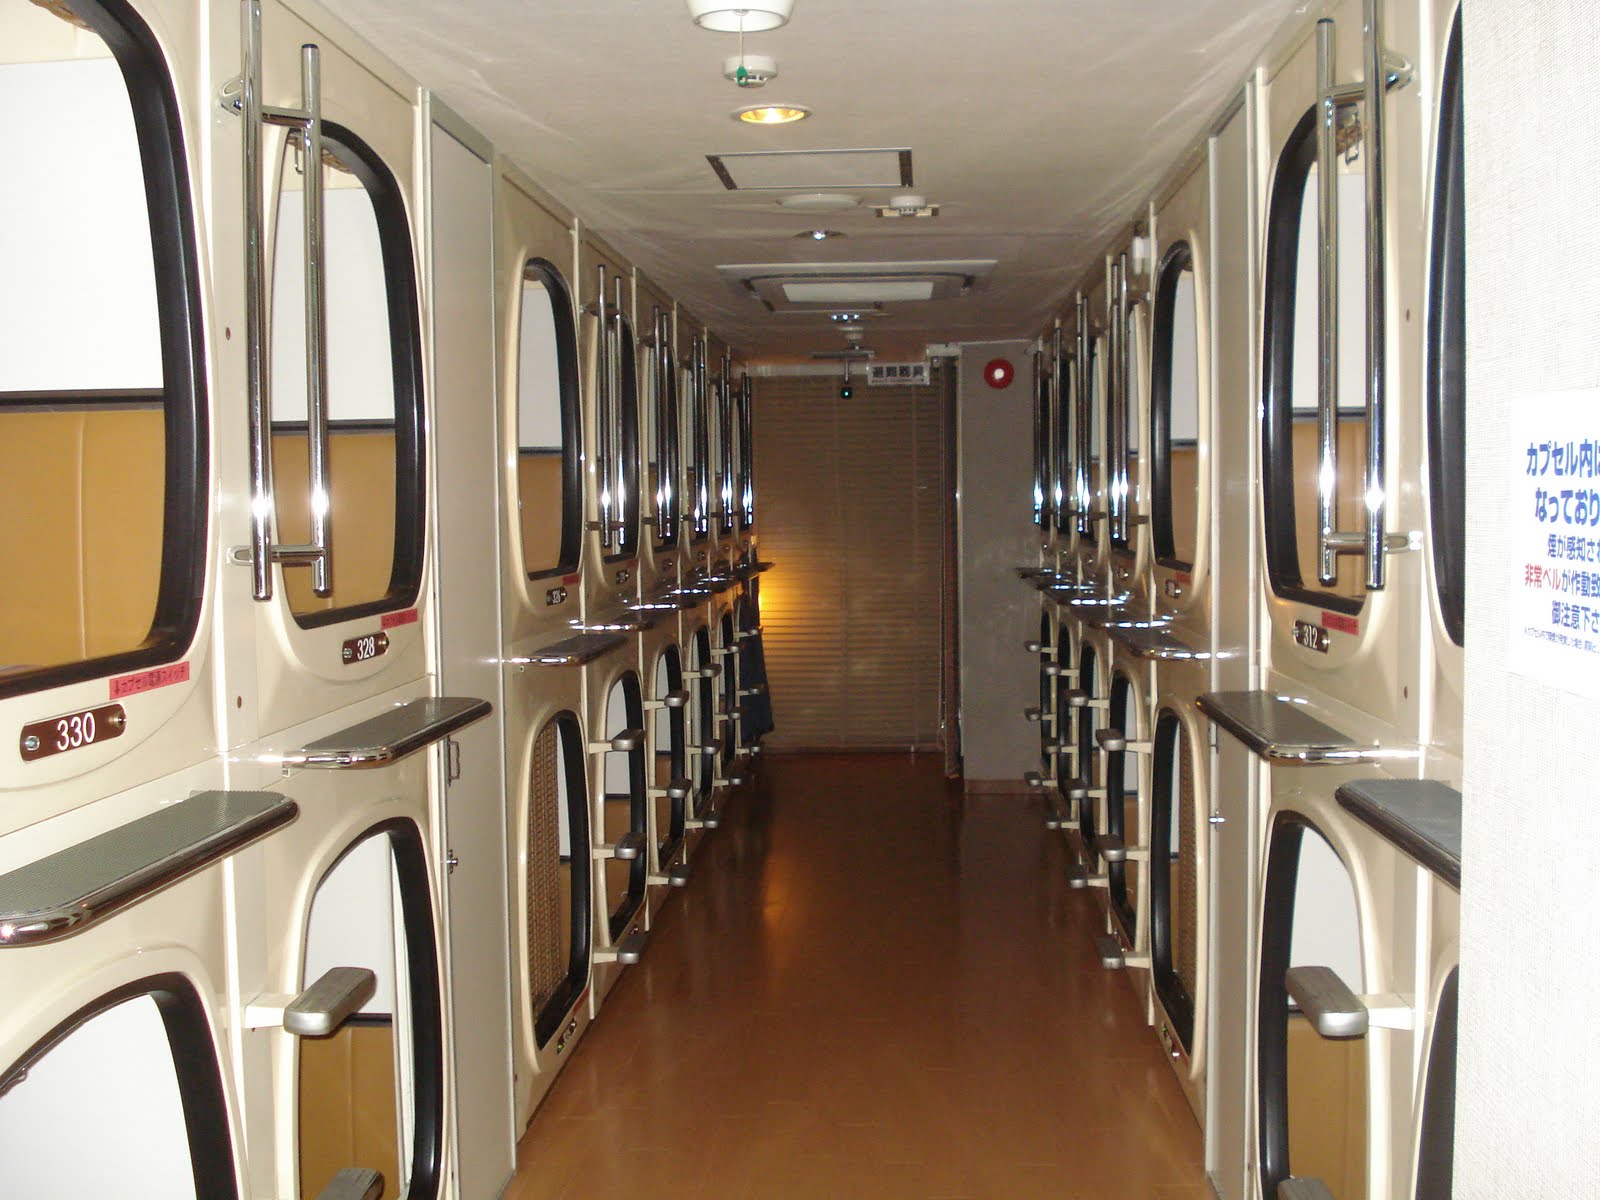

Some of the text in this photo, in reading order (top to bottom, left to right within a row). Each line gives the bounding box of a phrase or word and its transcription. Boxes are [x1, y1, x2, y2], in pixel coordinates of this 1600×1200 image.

[1535, 487, 1600, 527] なっており
[1548, 533, 1600, 564] 煙が感知さ
[357, 636, 376, 660] 328
[1303, 625, 1318, 649] 312
[56, 712, 96, 751] 330
